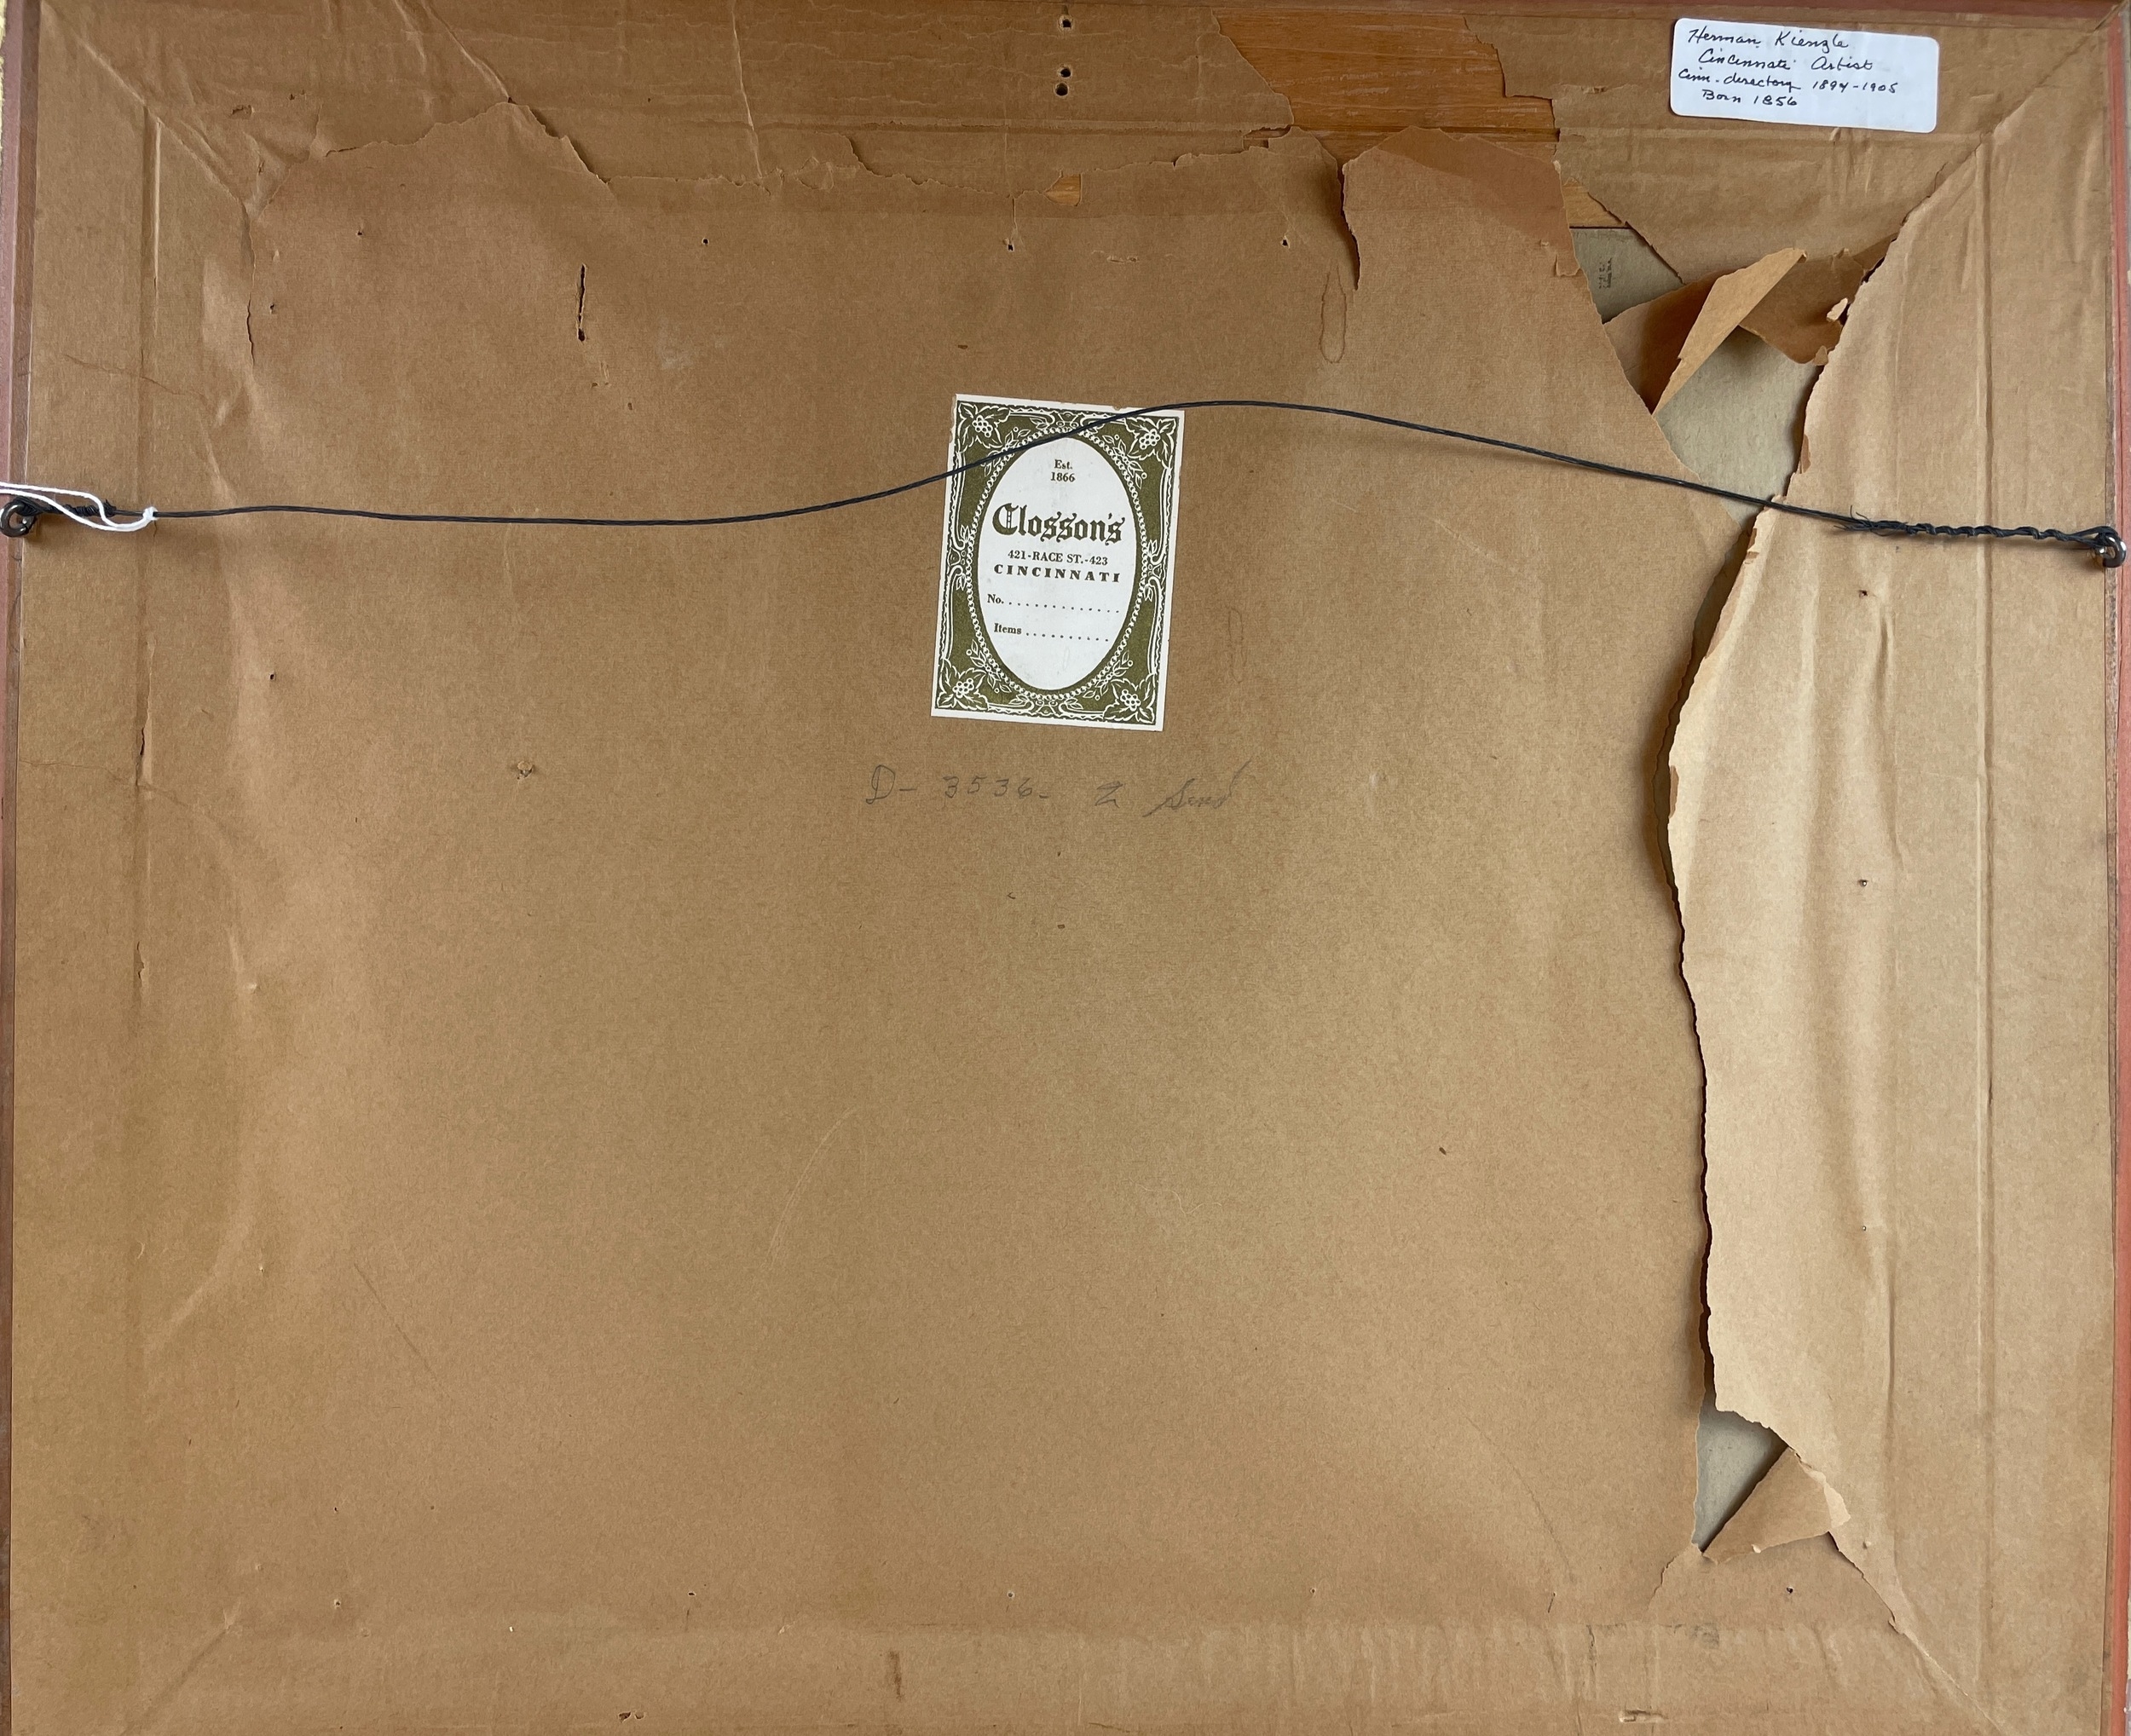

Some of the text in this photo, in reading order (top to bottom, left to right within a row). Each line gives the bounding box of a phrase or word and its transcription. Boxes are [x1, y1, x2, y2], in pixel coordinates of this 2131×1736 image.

[1698, 47, 1874, 71] Cincinnati Artist
[1701, 89, 1798, 107] Born 1856
[1054, 459, 1073, 470] Est.
[1050, 472, 1076, 482] 1866
[992, 502, 1126, 545] Closson's
[993, 563, 1120, 583] CINCINNATI
[994, 622, 1022, 635] Items
